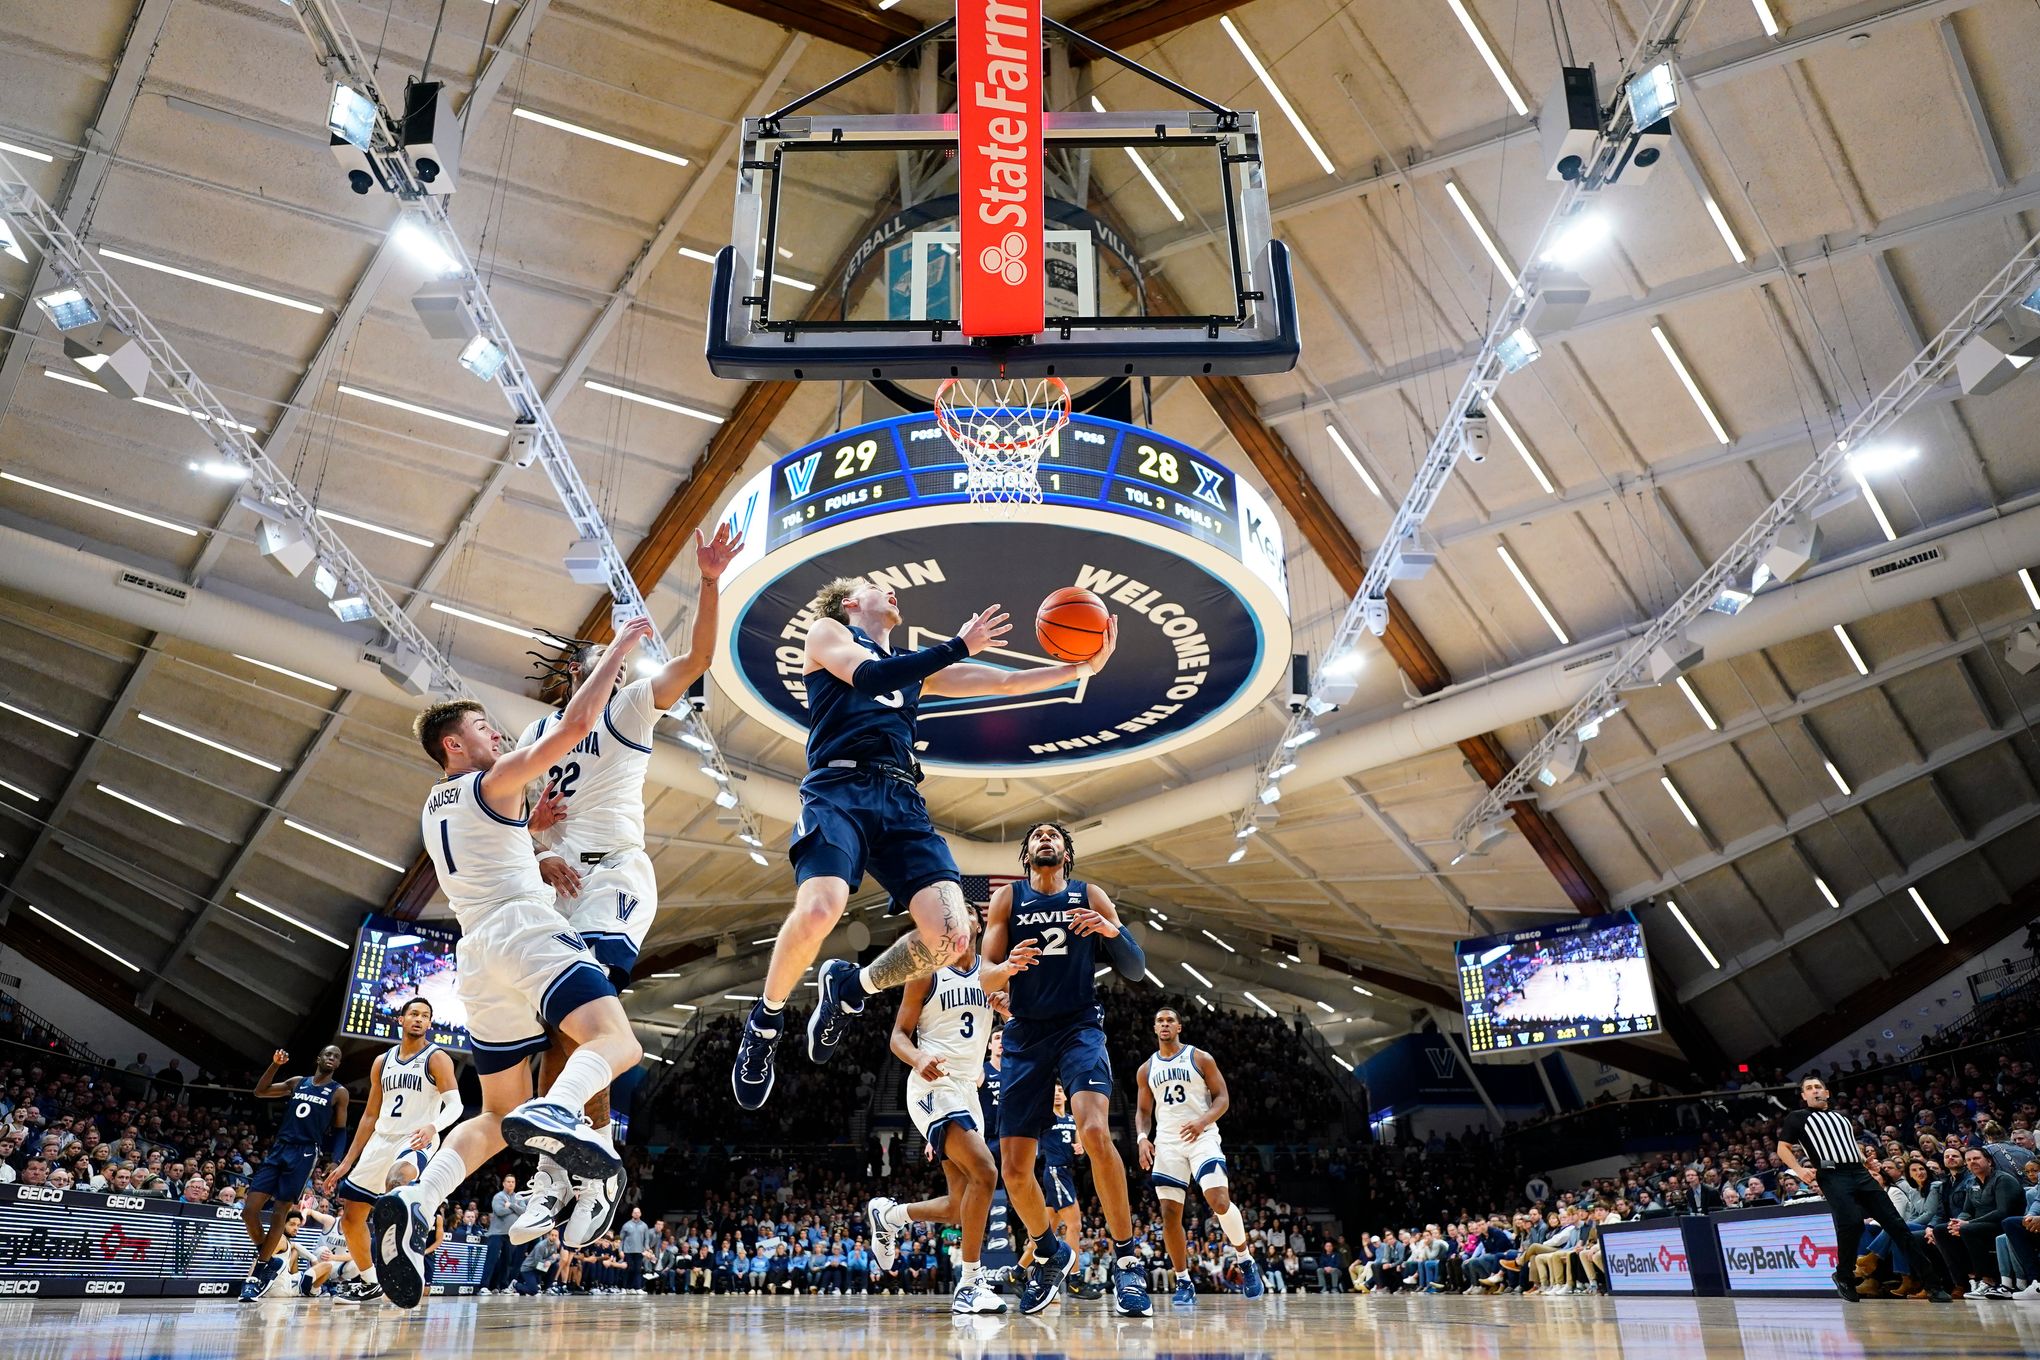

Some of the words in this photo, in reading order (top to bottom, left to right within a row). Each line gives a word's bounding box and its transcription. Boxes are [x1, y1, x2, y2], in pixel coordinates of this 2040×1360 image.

[910, 427, 943, 441] POSS
[1074, 430, 1106, 445] POSS
[833, 439, 878, 480] 29
[1137, 445, 1180, 484] 28
[1049, 474, 1060, 490] 1
[782, 512, 804, 529] TOL
[806, 505, 816, 519] 3
[825, 488, 869, 512] FOULS
[872, 484, 883, 499] 5
[1125, 487, 1153, 507] TOL
[1155, 497, 1166, 510] 3
[1174, 502, 1212, 530] FOULS
[1214, 520, 1222, 534] 7
[1074, 564, 1211, 671] WELCOME
[1166, 671, 1208, 700] TO
[1114, 703, 1184, 733] THE
[1028, 730, 1121, 754] FINN
[548, 762, 581, 799] 22
[428, 787, 462, 815] HAUSEN
[440, 818, 458, 874] 1
[1016, 910, 1075, 926] XAVIE
[1040, 927, 1069, 955] 2
[1515, 930, 1541, 941] GRECO
[940, 987, 988, 1011] VILLANOV
[960, 1011, 974, 1039] 3
[382, 1073, 423, 1093] VILLANOVA
[1152, 1068, 1191, 1088] VILLANOVA
[292, 1092, 328, 1106] XAVIER
[391, 1094, 404, 1117] 2
[1163, 1085, 1186, 1105] 43
[295, 1102, 311, 1118] 0
[1061, 1130, 1072, 1143] 3
[17, 1186, 64, 1202] GEICO
[106, 1195, 145, 1210] GEICO
[1608, 1252, 1660, 1276] KeyBank
[1726, 1244, 1800, 1274] KeyBank
[85, 1281, 125, 1294] GEICO
[198, 1282, 230, 1294] GEICO
